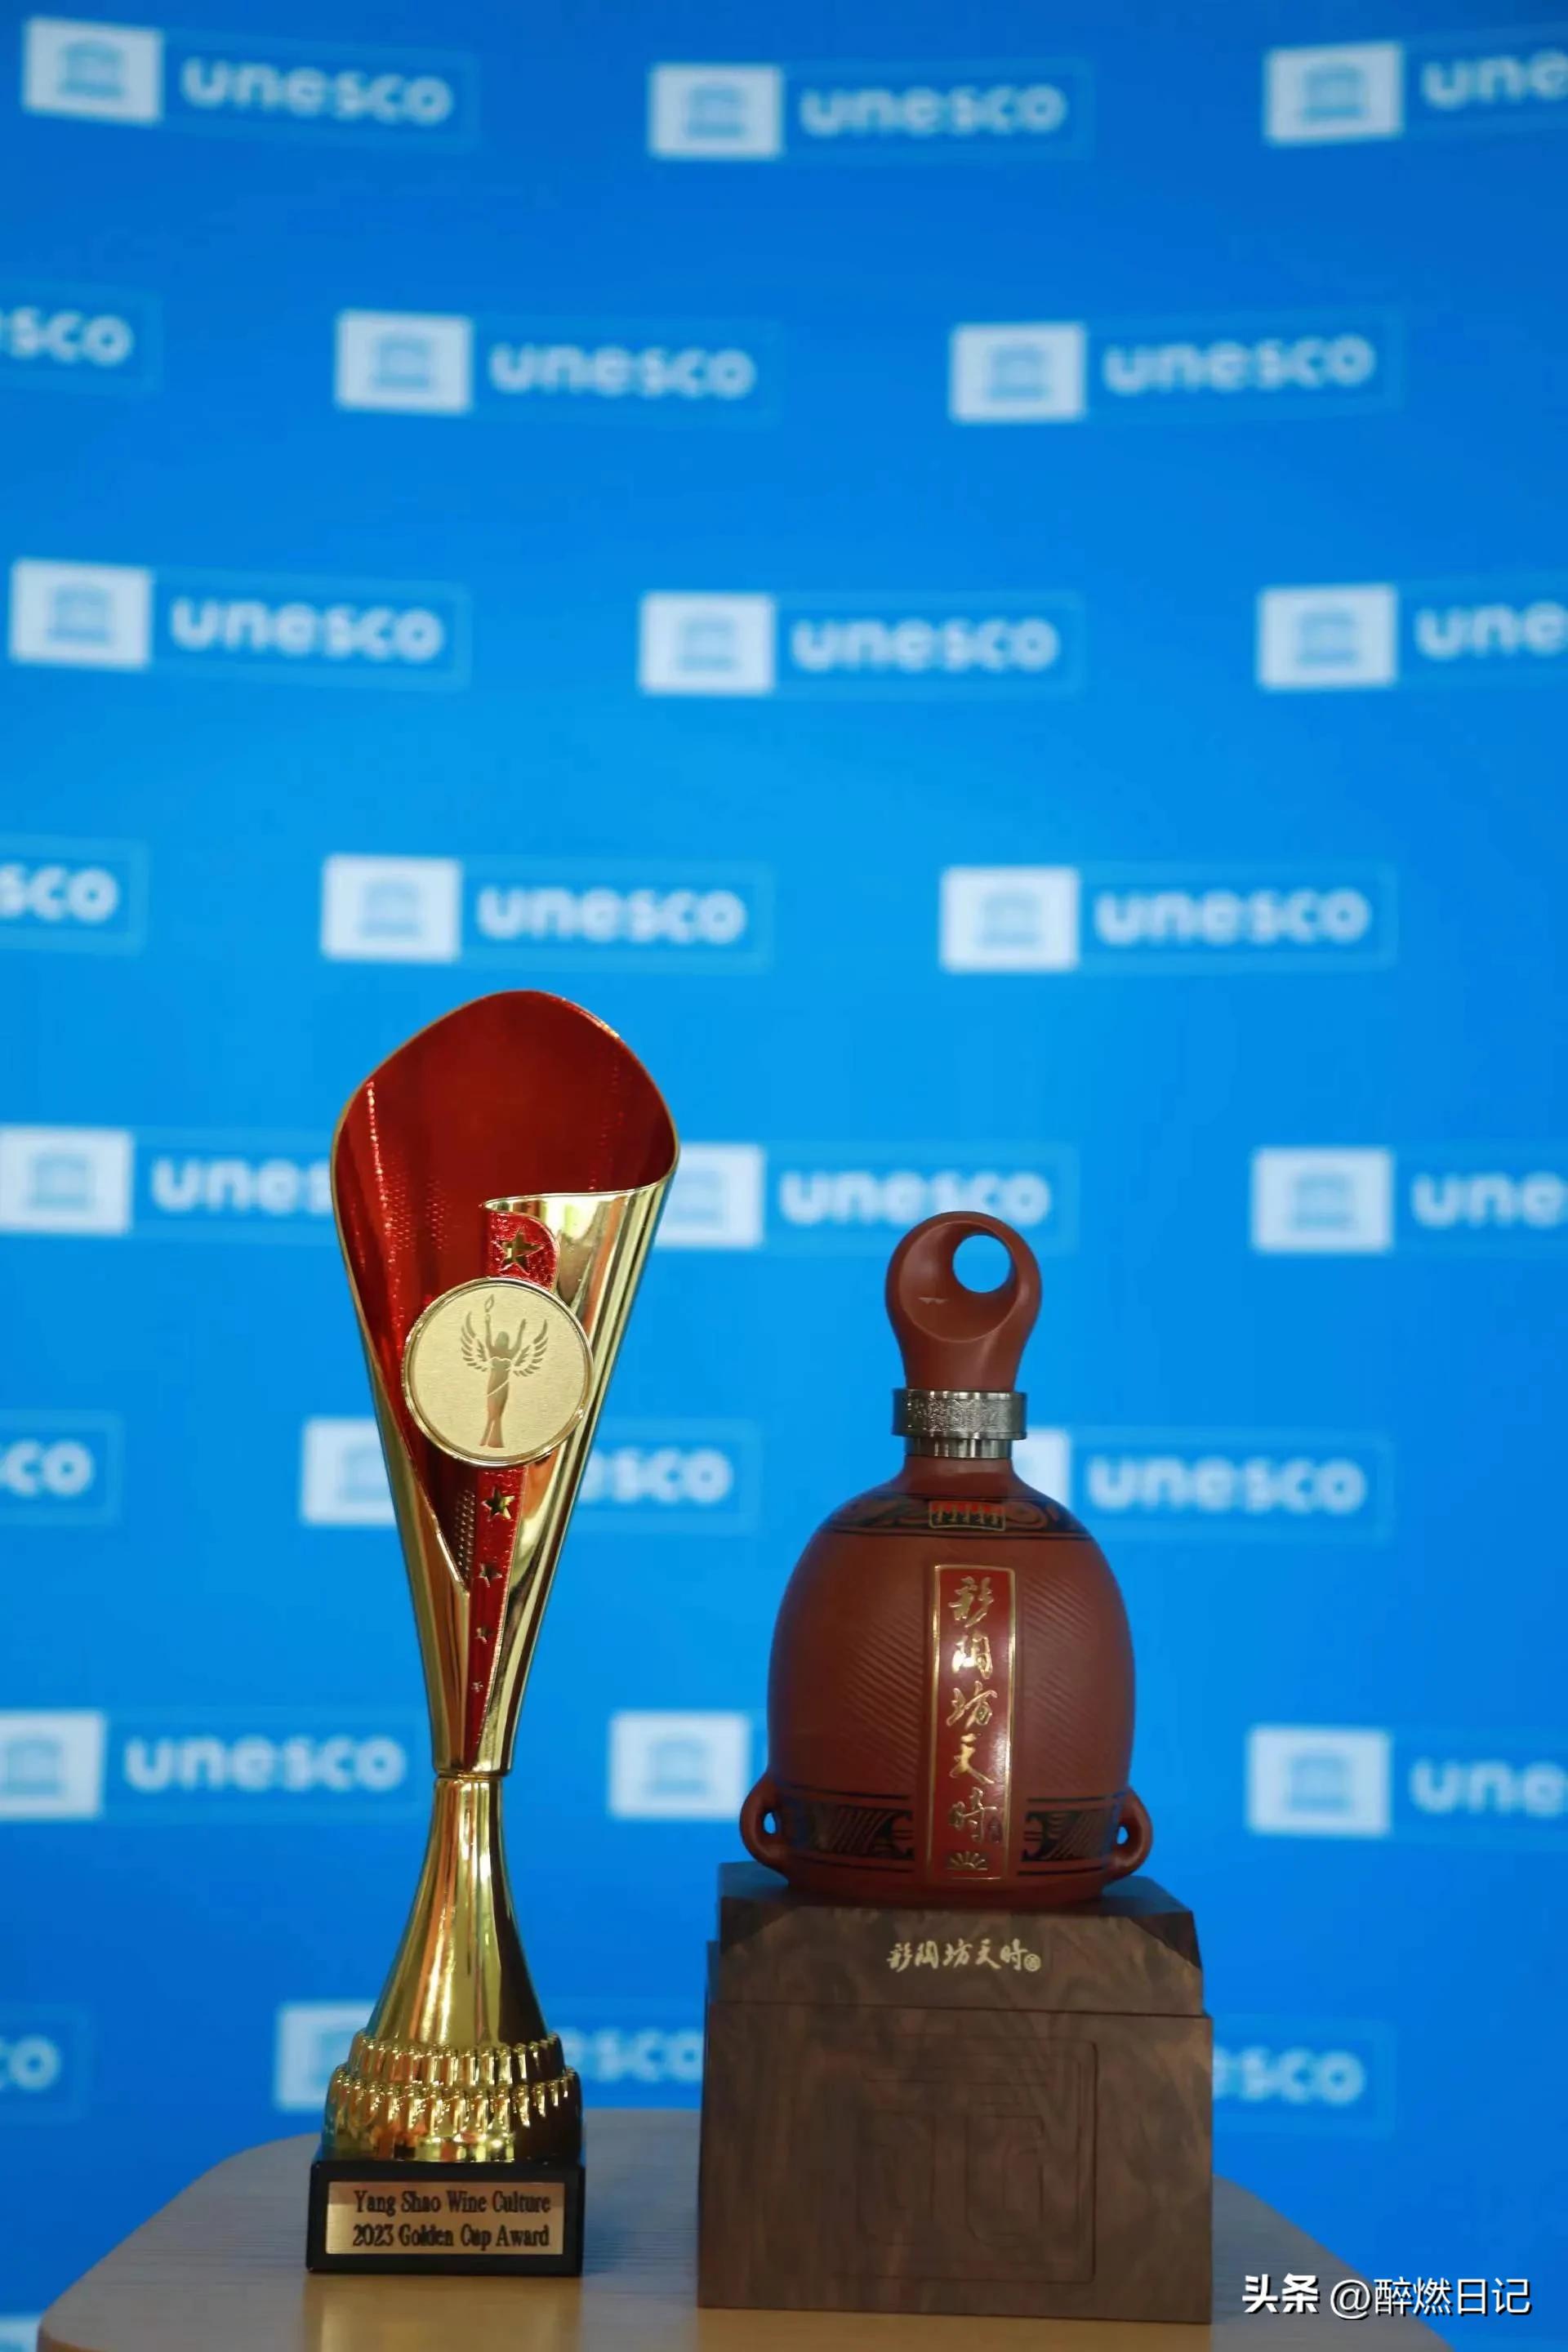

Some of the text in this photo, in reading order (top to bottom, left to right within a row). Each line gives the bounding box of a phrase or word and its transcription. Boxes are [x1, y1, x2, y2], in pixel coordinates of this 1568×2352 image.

[183, 59, 452, 124] unesco
[800, 85, 1066, 136] unesco
[0, 307, 132, 364] sco
[490, 345, 755, 399] unesco
[1103, 336, 1374, 394] unesco
[171, 599, 443, 662] unesco
[791, 618, 1058, 671] unesco
[477, 888, 746, 944] unesco
[1094, 890, 1370, 945] unesco
[151, 1159, 331, 1214] unes
[778, 1171, 1051, 1225] unesco
[1087, 1457, 1365, 1513] unesco
[125, 1736, 407, 1791] unesco
[354, 2190, 551, 2216] Yang Shao Wine Culture
[353, 2224, 550, 2251] 2023 Golden Cup Award
